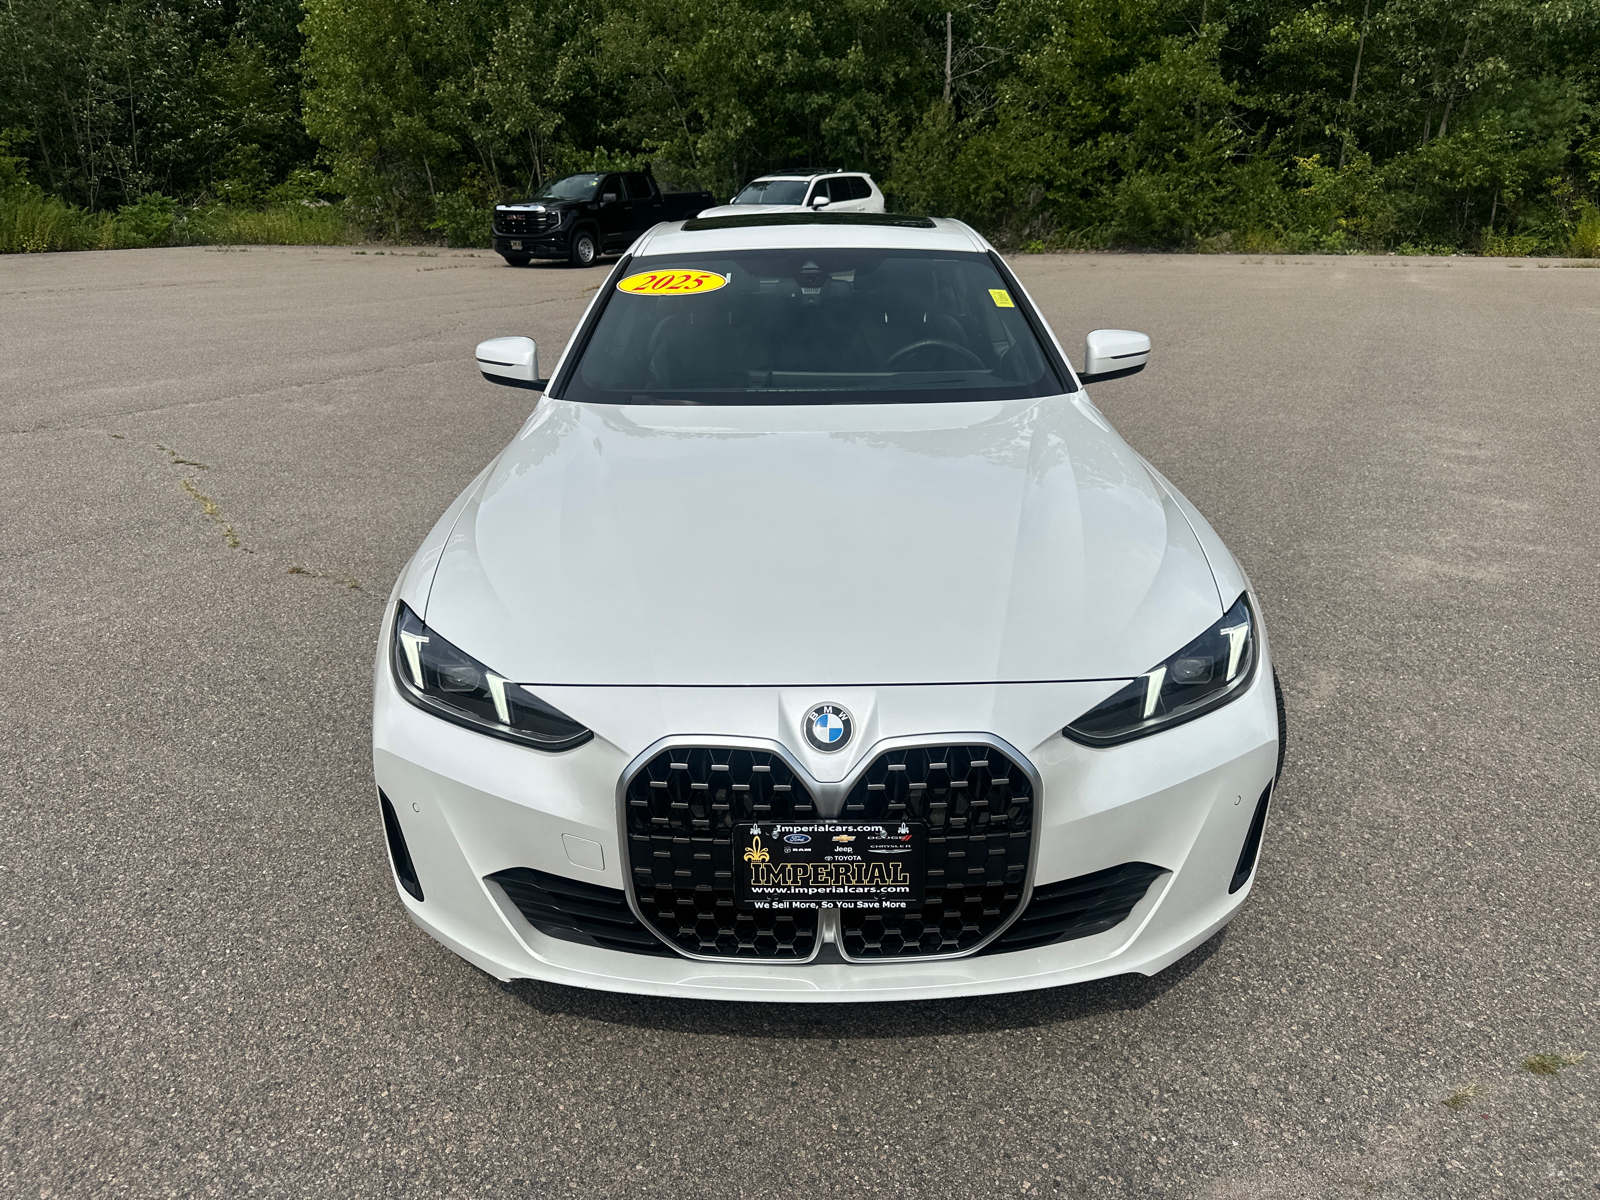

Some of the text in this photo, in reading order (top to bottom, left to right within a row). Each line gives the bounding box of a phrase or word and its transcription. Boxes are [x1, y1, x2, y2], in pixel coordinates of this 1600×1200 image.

[632, 275, 711, 291] 2025
[808, 706, 849, 721] BMW
[776, 824, 883, 833] Imperialcars.com
[750, 862, 910, 886] IMPERIAL
[751, 885, 910, 895] www.imperialcars.com
[754, 901, 770, 909] We
[772, 901, 790, 909] Sell
[792, 901, 819, 910] More,
[821, 901, 834, 909] So
[856, 901, 880, 909] Save
